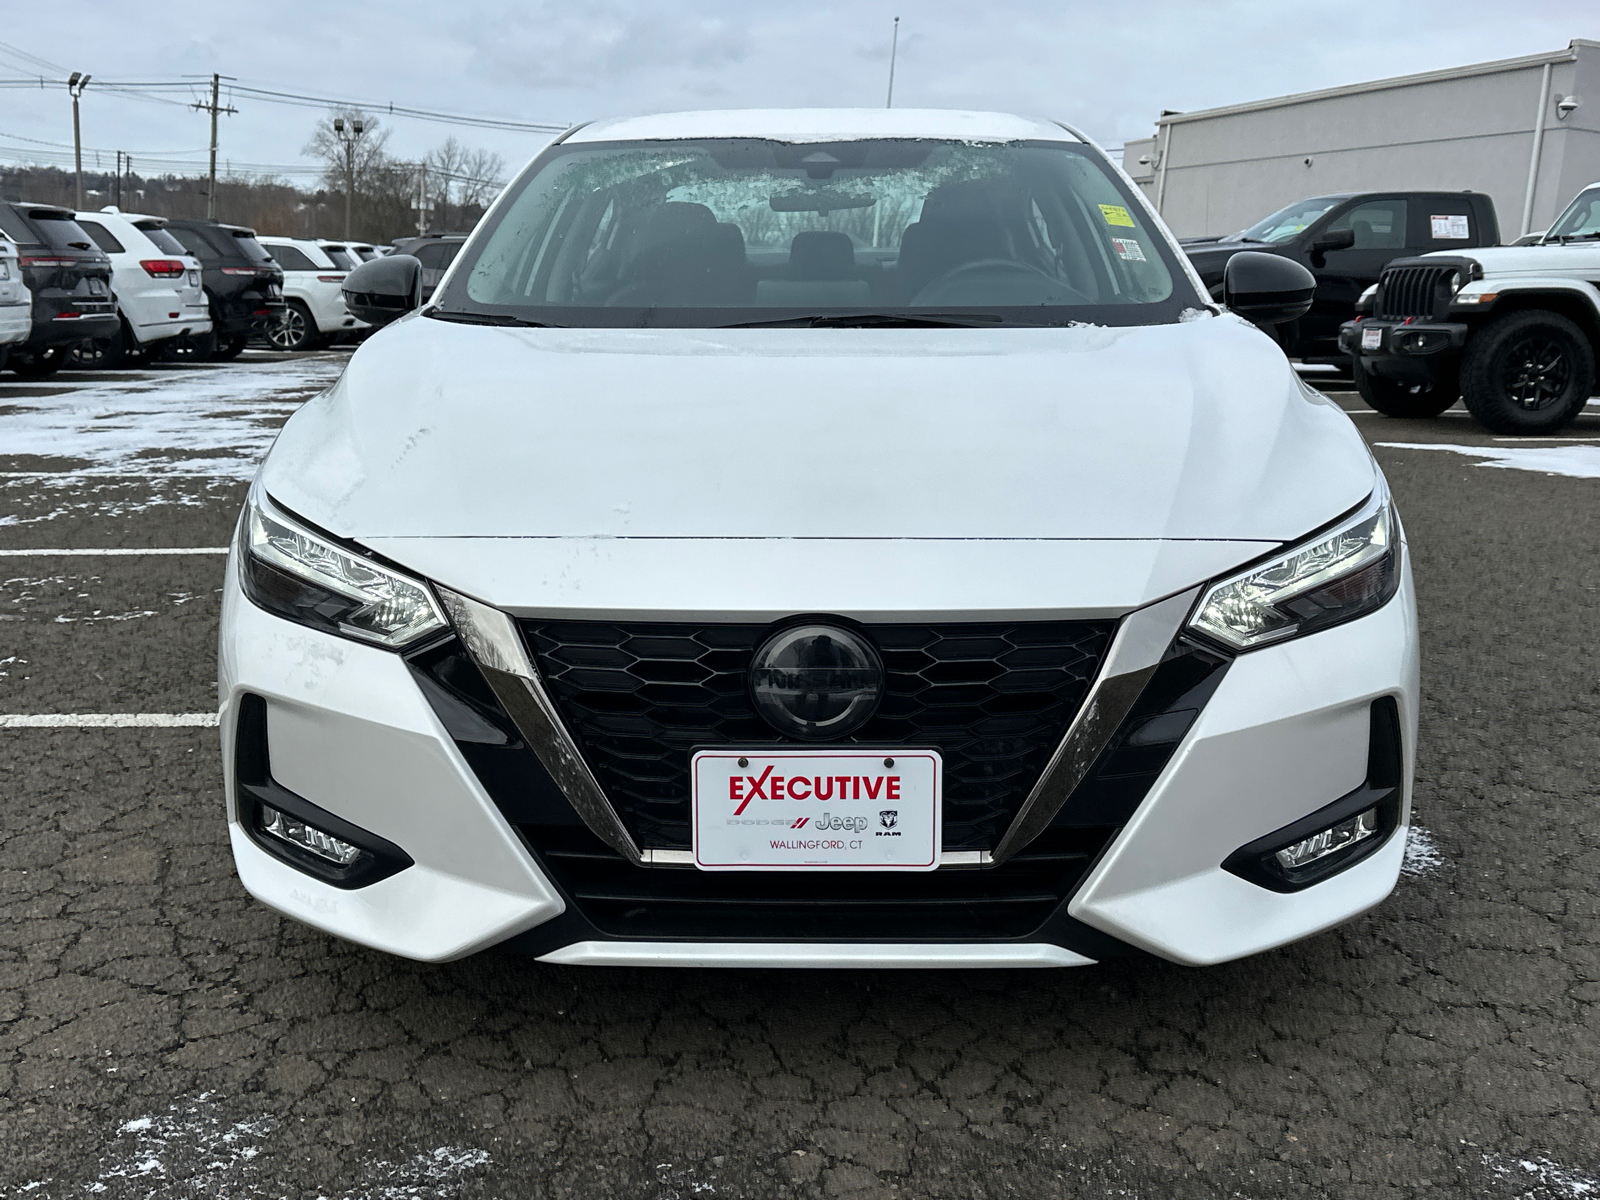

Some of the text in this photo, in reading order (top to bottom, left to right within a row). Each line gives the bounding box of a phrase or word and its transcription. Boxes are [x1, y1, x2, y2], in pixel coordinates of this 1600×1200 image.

[729, 765, 901, 816] EXECUTIVE
[726, 812, 868, 833] DODGE Jeep
[769, 840, 863, 850] WALLINGFORD, CT
